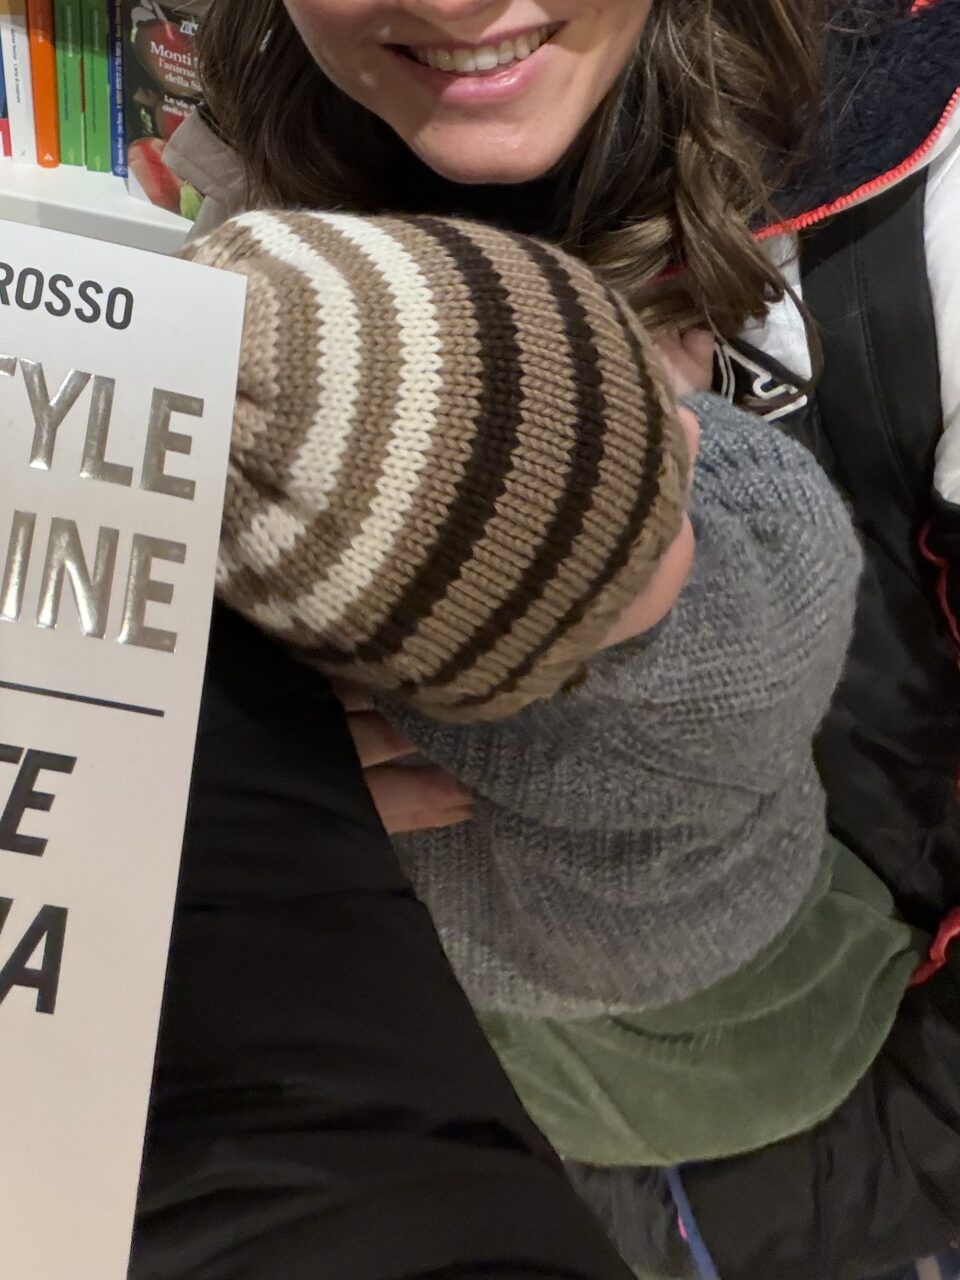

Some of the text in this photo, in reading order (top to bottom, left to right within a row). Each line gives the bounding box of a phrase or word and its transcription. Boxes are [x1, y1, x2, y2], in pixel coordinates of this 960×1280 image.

[149, 41, 193, 66] Monti
[159, 56, 196, 77] l'anima
[164, 72, 189, 88] della
[163, 94, 189, 109] Le vie
[161, 103, 183, 117] della
